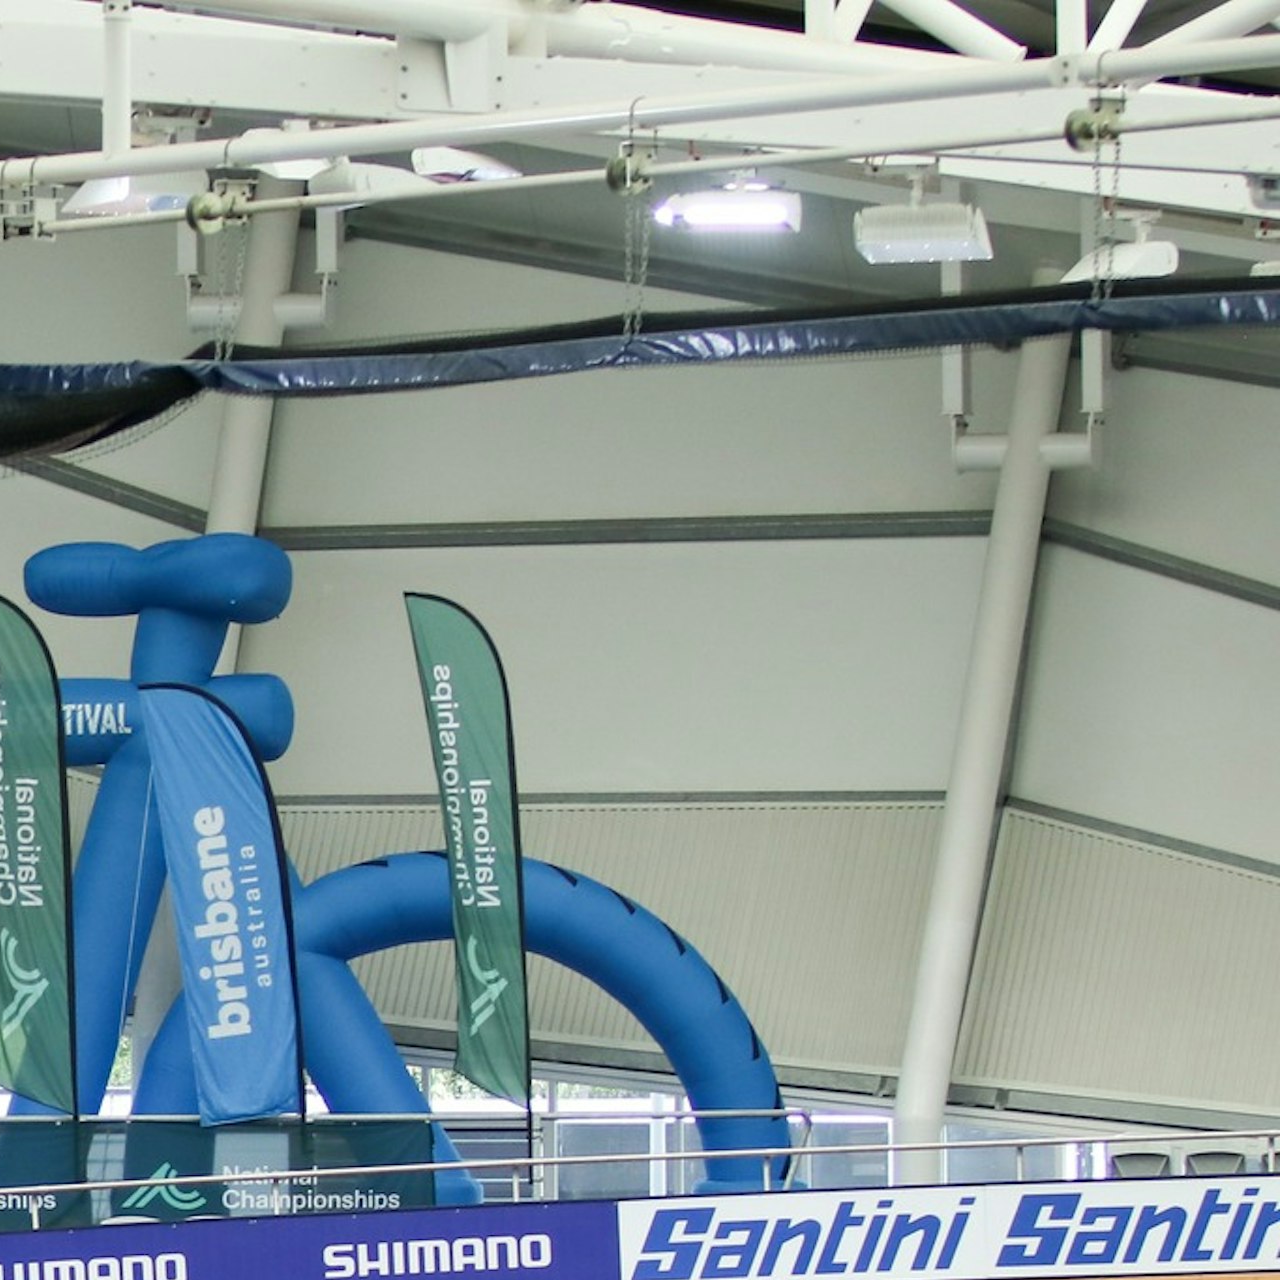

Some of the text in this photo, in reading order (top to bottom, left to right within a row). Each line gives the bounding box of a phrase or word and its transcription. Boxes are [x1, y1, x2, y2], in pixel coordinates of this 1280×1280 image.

[61, 703, 132, 736] TIVAL
[193, 806, 251, 1040] brisbane
[240, 844, 272, 988] australia
[222, 1189, 400, 1214] Championships
[323, 1233, 552, 1280] SHIMANO
